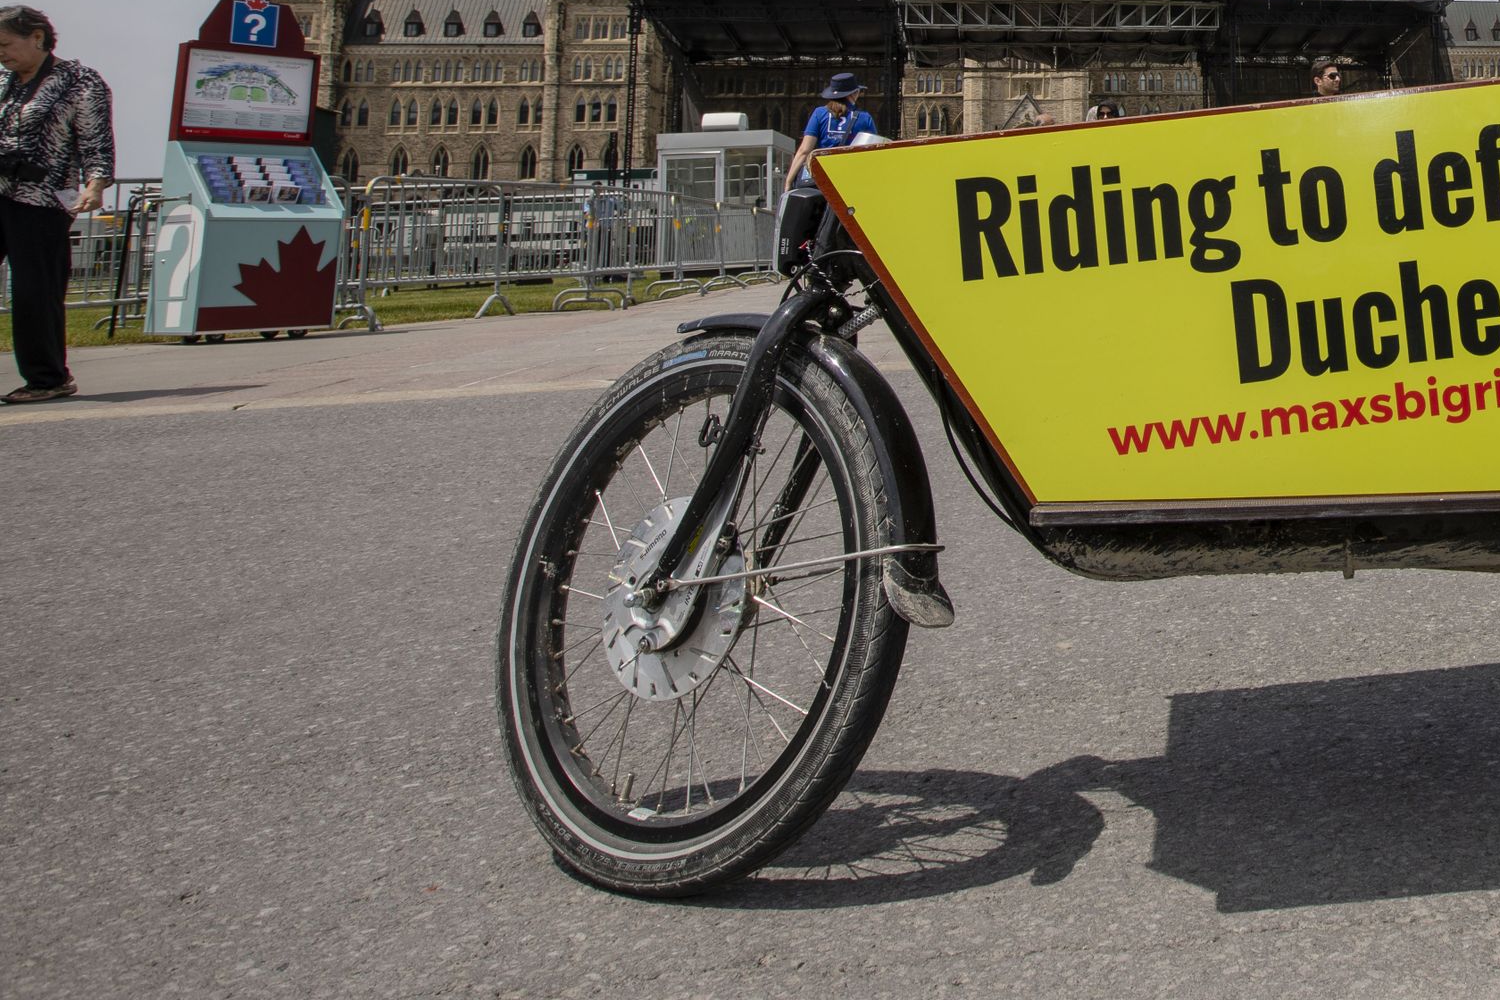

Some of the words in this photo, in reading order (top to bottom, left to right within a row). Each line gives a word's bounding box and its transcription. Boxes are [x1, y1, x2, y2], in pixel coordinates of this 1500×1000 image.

[956, 166, 1241, 281] Riding
[1258, 149, 1347, 246] to
[598, 365, 660, 416] SCHWALBE
[708, 350, 750, 361] MARATH
